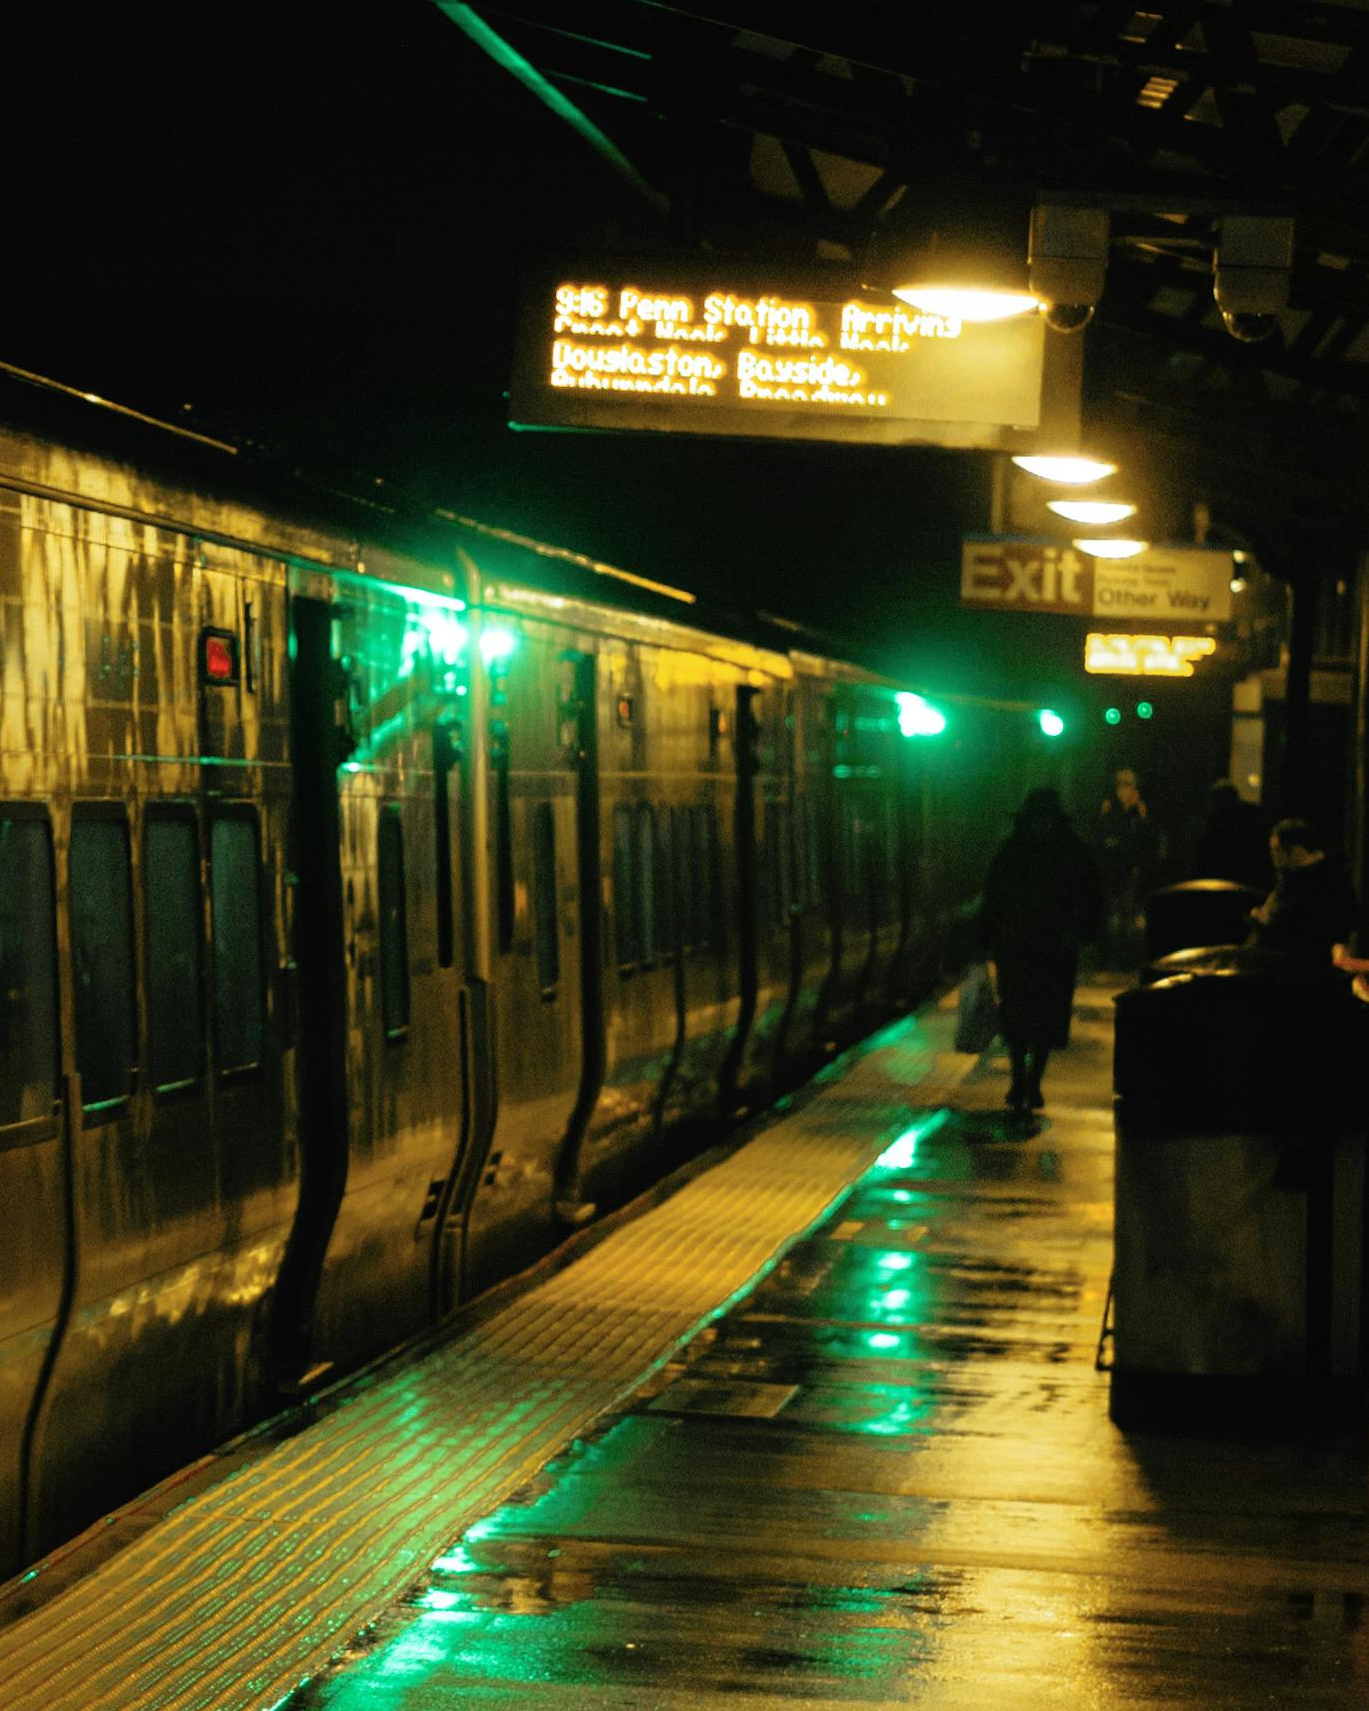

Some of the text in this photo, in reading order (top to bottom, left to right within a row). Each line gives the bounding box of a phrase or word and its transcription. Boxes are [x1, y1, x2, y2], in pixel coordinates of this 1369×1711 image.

[555, 289, 962, 339] 9:16 Penn Station Arriving
[737, 352, 861, 387] Bayside,
[962, 546, 1082, 603] Exit
[1098, 588, 1210, 611] Other Way
